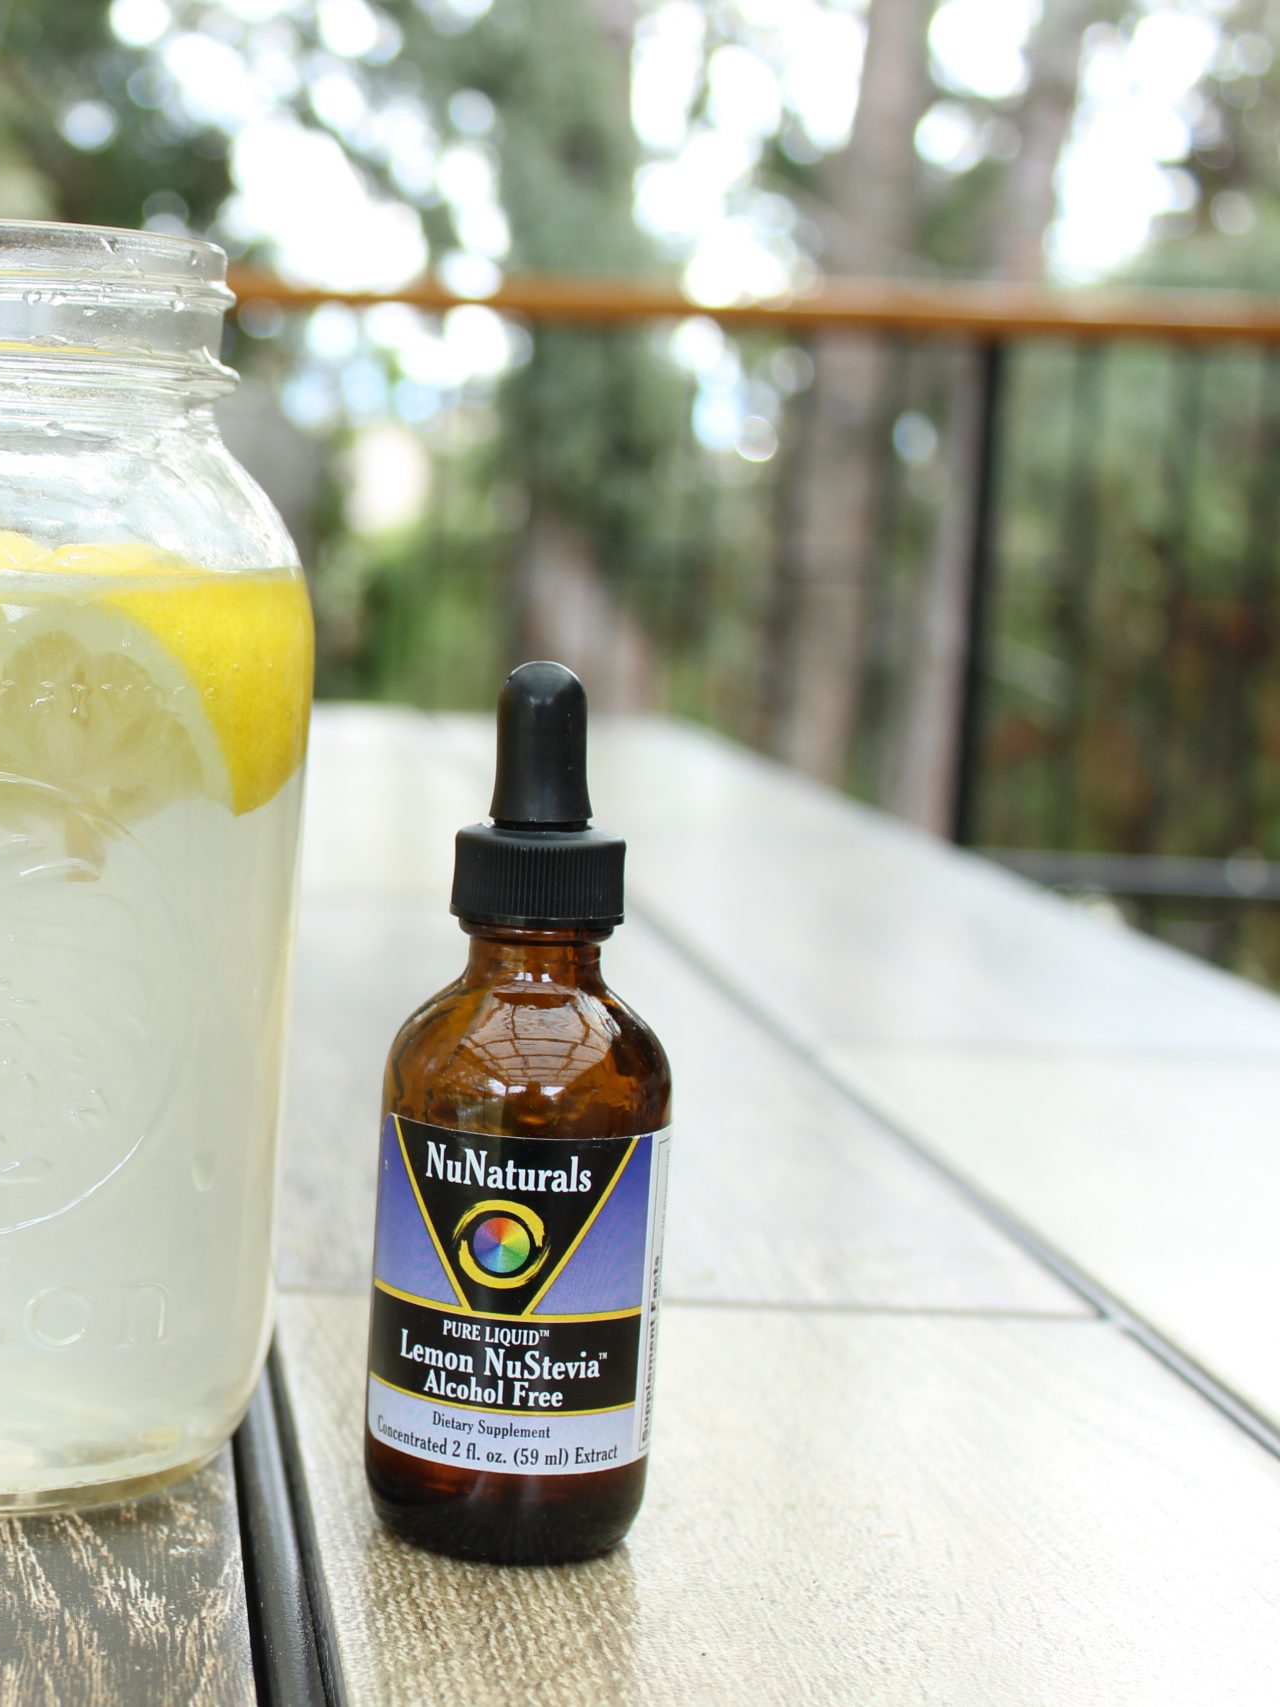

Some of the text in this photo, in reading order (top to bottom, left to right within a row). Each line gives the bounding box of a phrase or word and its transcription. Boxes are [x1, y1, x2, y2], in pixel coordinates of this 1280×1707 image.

[426, 1140, 592, 1193] NuNaturals
[400, 1328, 474, 1374] Lemon
[443, 1319, 480, 1341] PURE
[423, 1369, 563, 1407] Alcohol Free
[377, 1415, 618, 1467] Concentrated 2 fl. oz. (59 ml) Extract
[432, 1411, 551, 1439] Dietary Supplement
